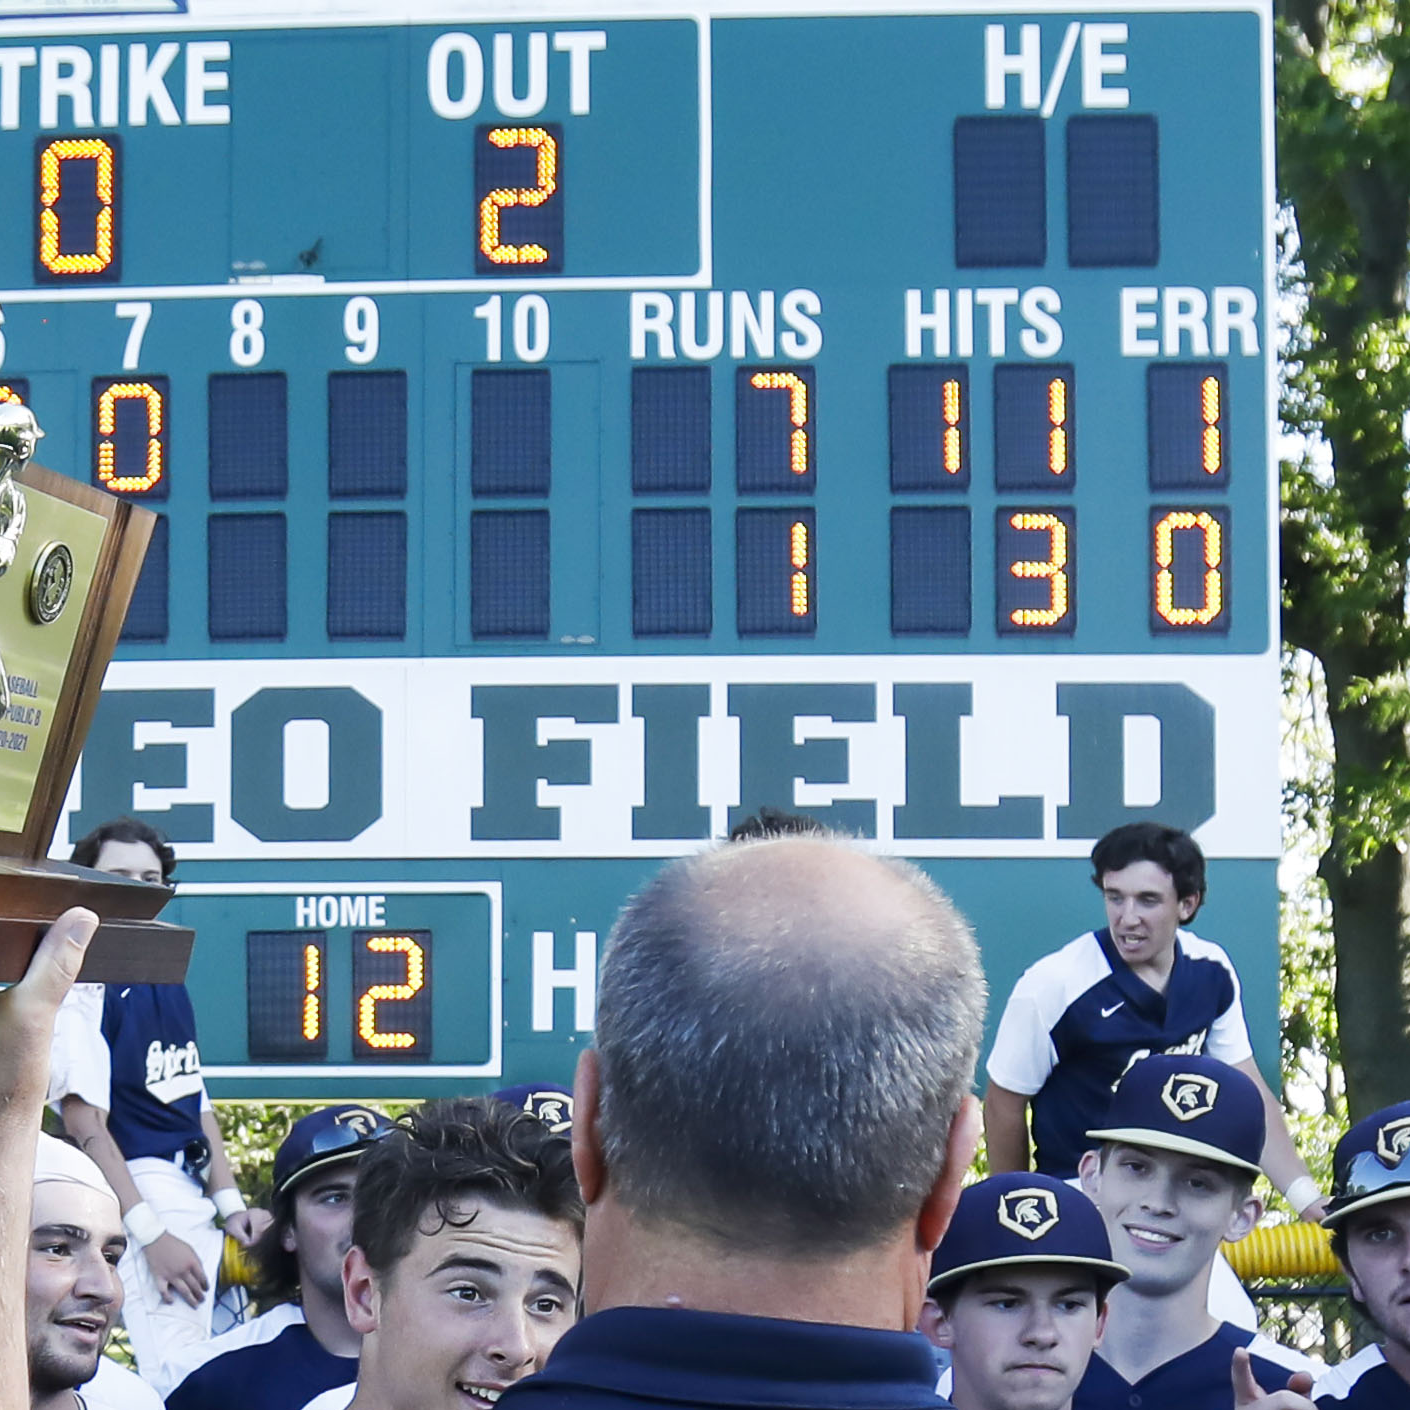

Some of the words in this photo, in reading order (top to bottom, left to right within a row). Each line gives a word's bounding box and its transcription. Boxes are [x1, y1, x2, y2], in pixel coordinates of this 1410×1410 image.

[428, 32, 607, 118] OUT
[985, 22, 1130, 118] H/E
[39, 139, 115, 275] 0
[479, 127, 557, 265] 2
[115, 302, 152, 370] 7
[229, 299, 265, 367] 8
[344, 296, 379, 364] 9
[474, 294, 550, 363] 10
[630, 290, 823, 360] RUNS
[905, 287, 1063, 357] HITS
[1120, 286, 1260, 357] ERR
[98, 383, 163, 493] 0
[750, 372, 809, 475] 7
[1201, 376, 1221, 474] 1
[790, 522, 809, 616] 1
[1009, 513, 1068, 627] 3
[1154, 511, 1222, 626] 0
[470, 682, 1216, 841] FIELD
[296, 895, 386, 928] HOME
[302, 936, 424, 1049] 12
